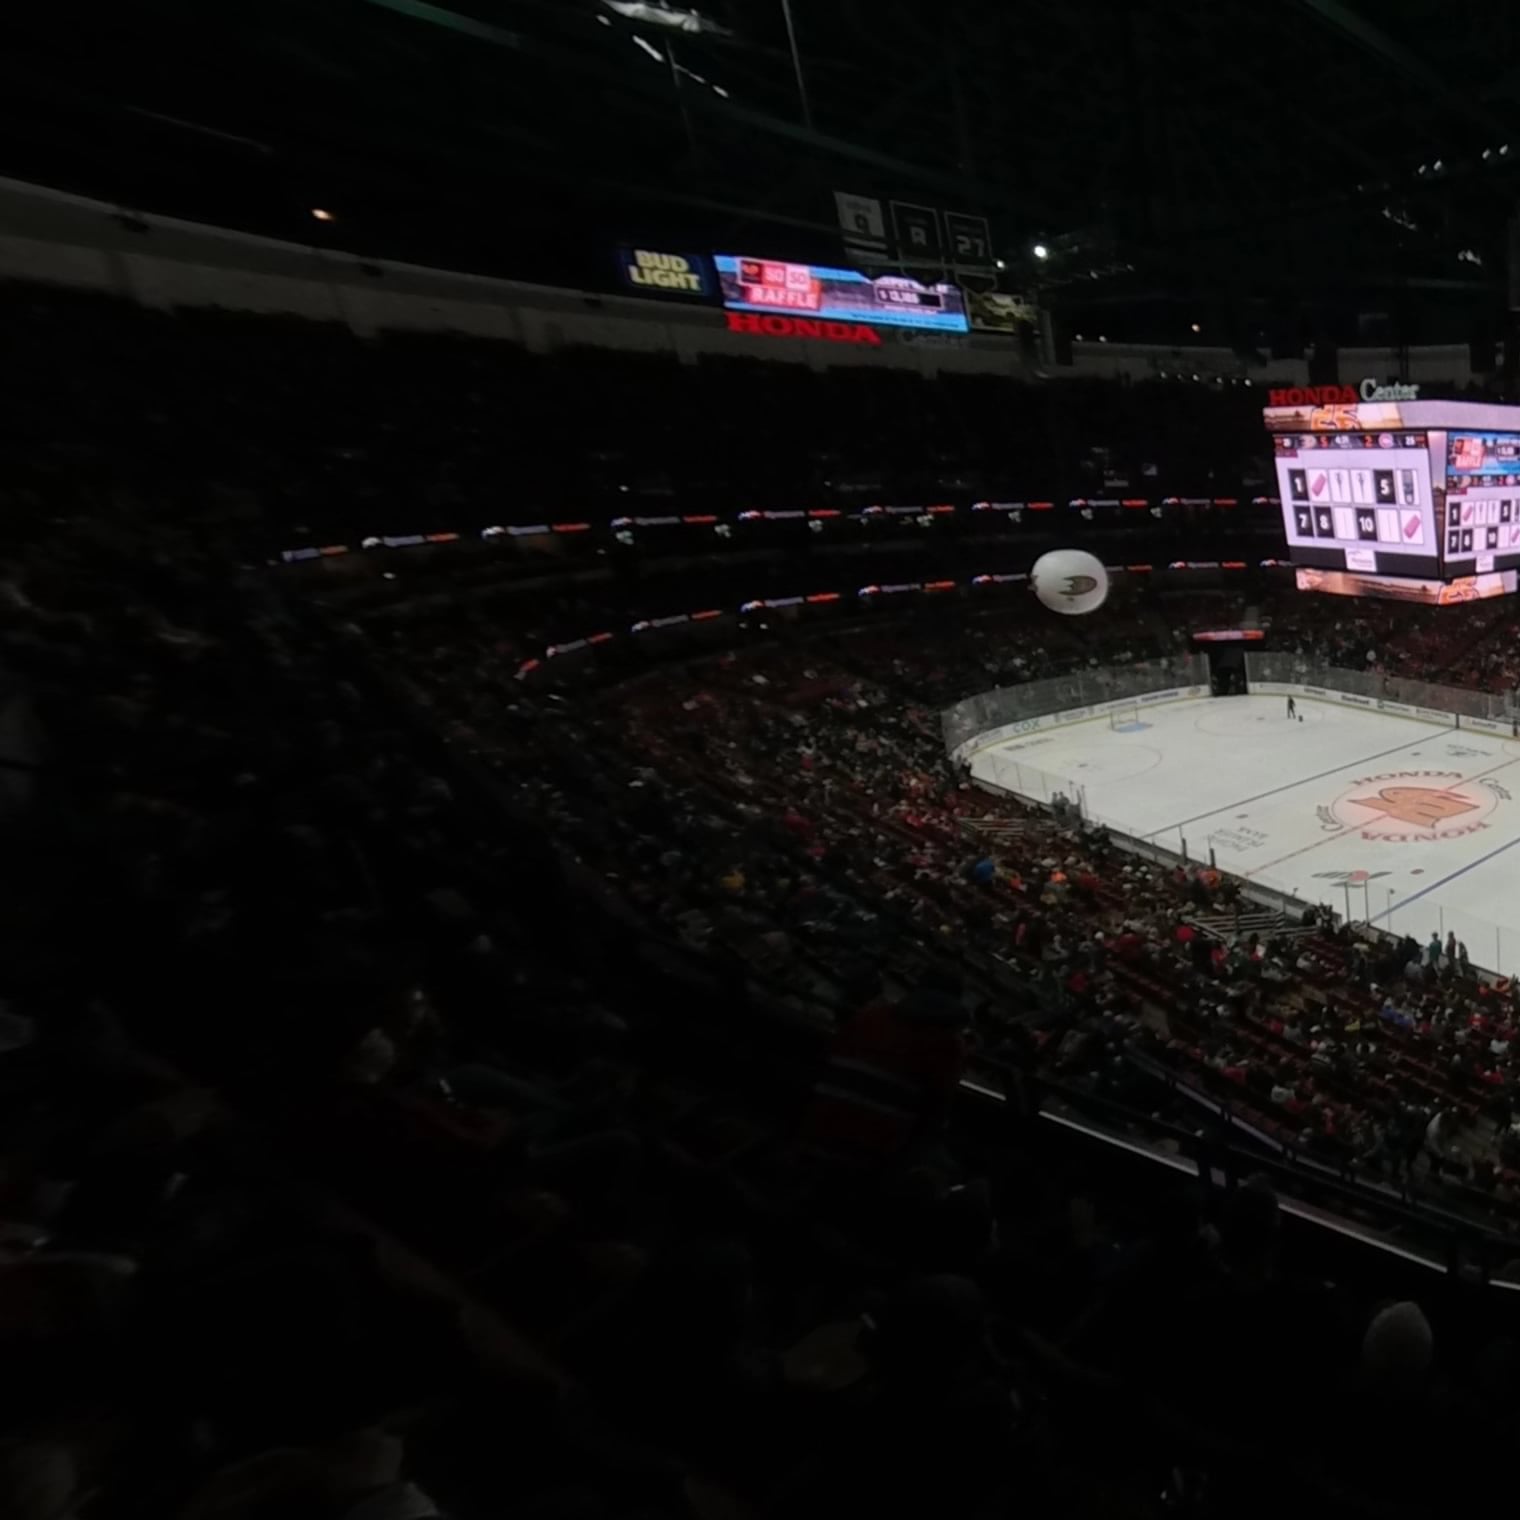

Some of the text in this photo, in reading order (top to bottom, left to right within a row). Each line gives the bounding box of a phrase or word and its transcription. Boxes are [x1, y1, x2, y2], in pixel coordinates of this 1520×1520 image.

[634, 249, 689, 273] BUD
[628, 264, 702, 291] LIGHT
[750, 286, 818, 310] RAFFLE
[725, 311, 883, 346] HONDA
[1269, 379, 1419, 406] HONDA Center
[1294, 477, 1390, 495] 1 5
[1298, 513, 1374, 532] 7 8 10
[1351, 770, 1464, 787] HONDA
[1361, 821, 1491, 843] HONDA
